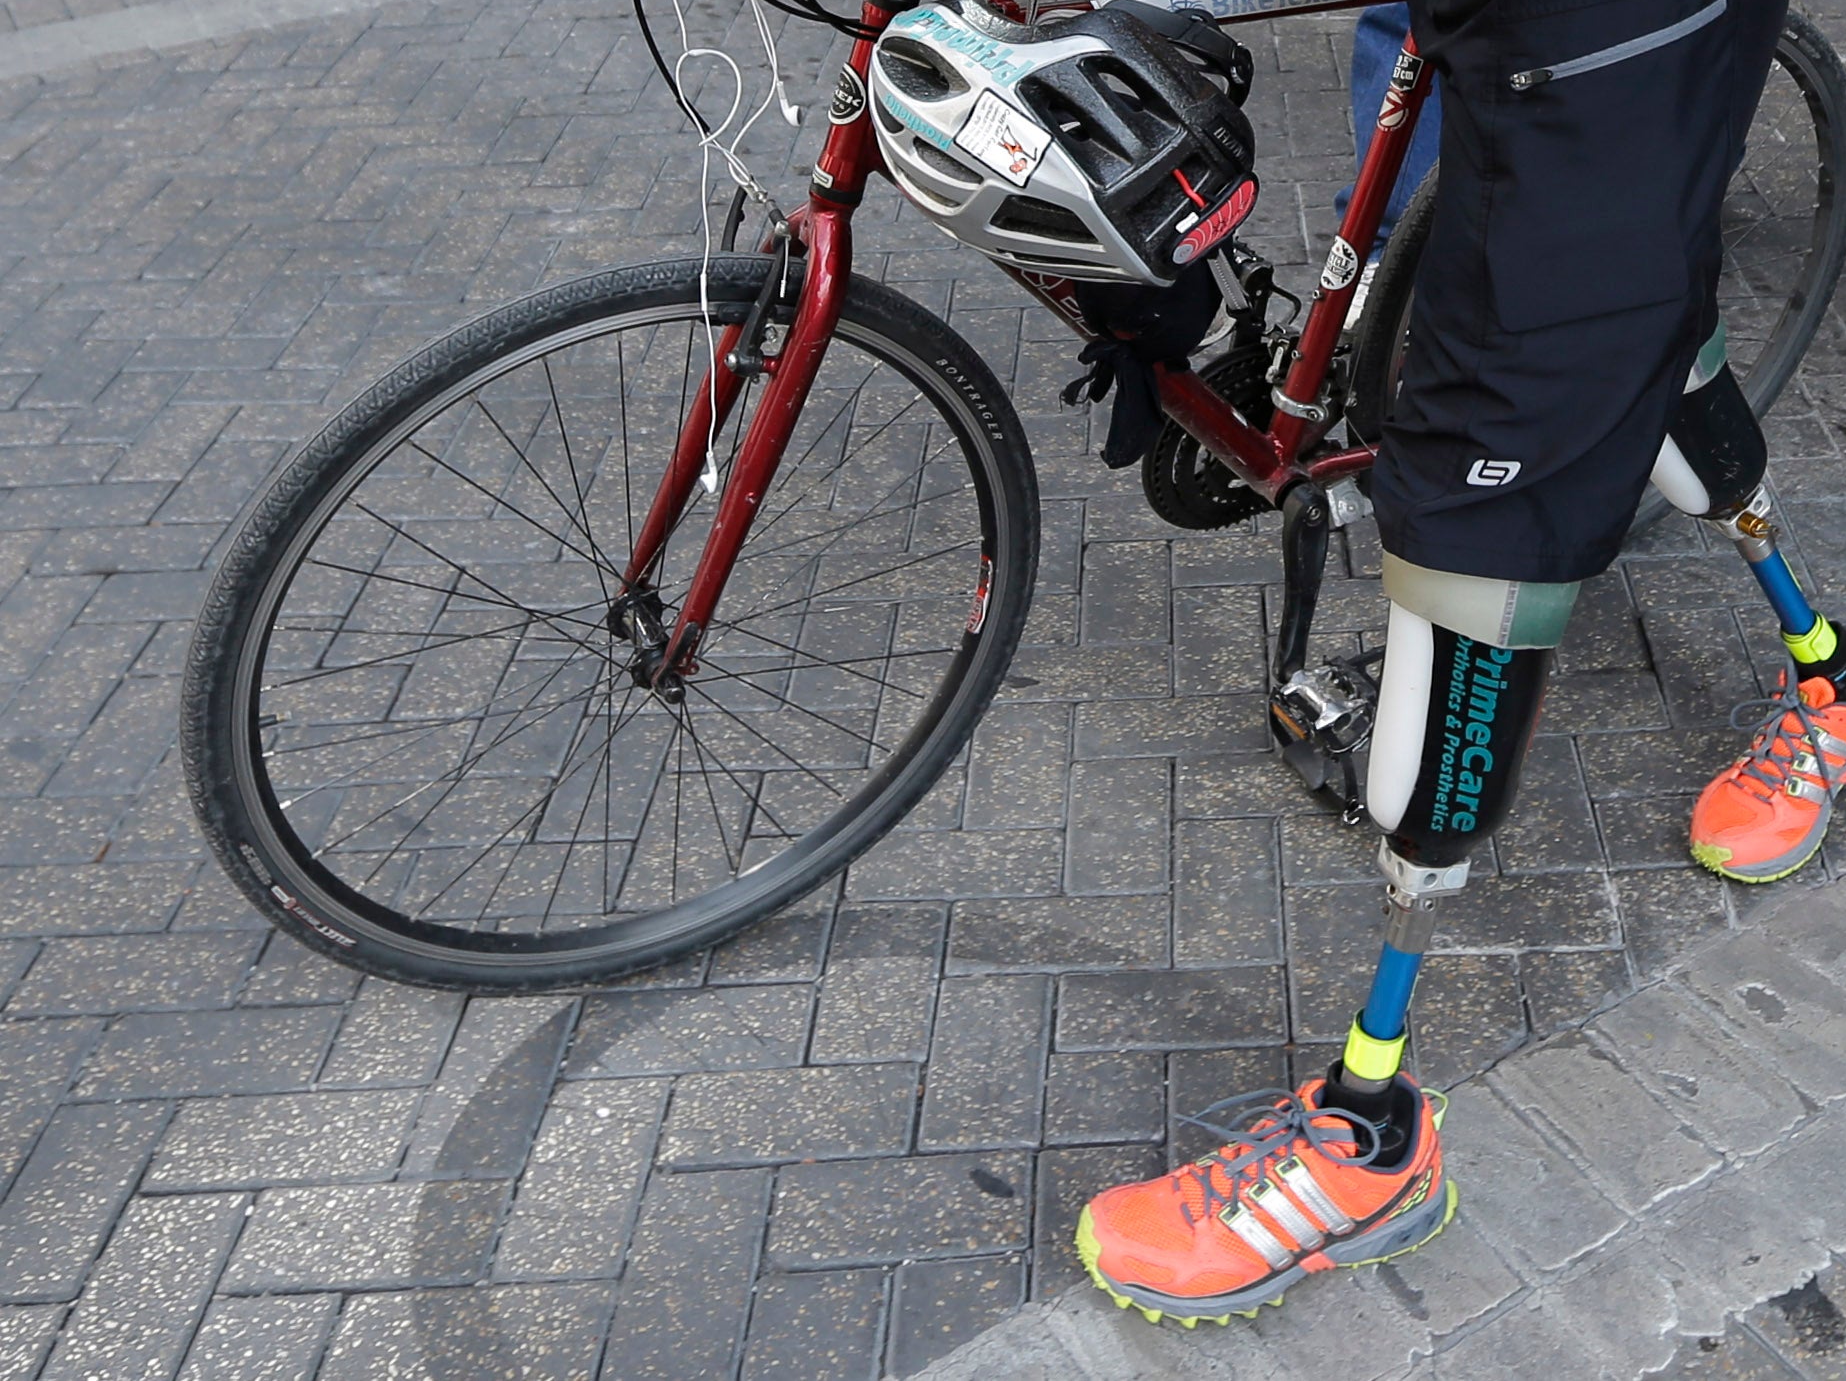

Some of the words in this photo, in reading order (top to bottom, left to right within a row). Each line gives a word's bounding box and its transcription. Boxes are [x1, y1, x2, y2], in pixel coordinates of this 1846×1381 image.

[935, 358, 1004, 440] BONTRAGER
[1446, 714, 1463, 729] &
[1431, 733, 1462, 832] Prosthetics
